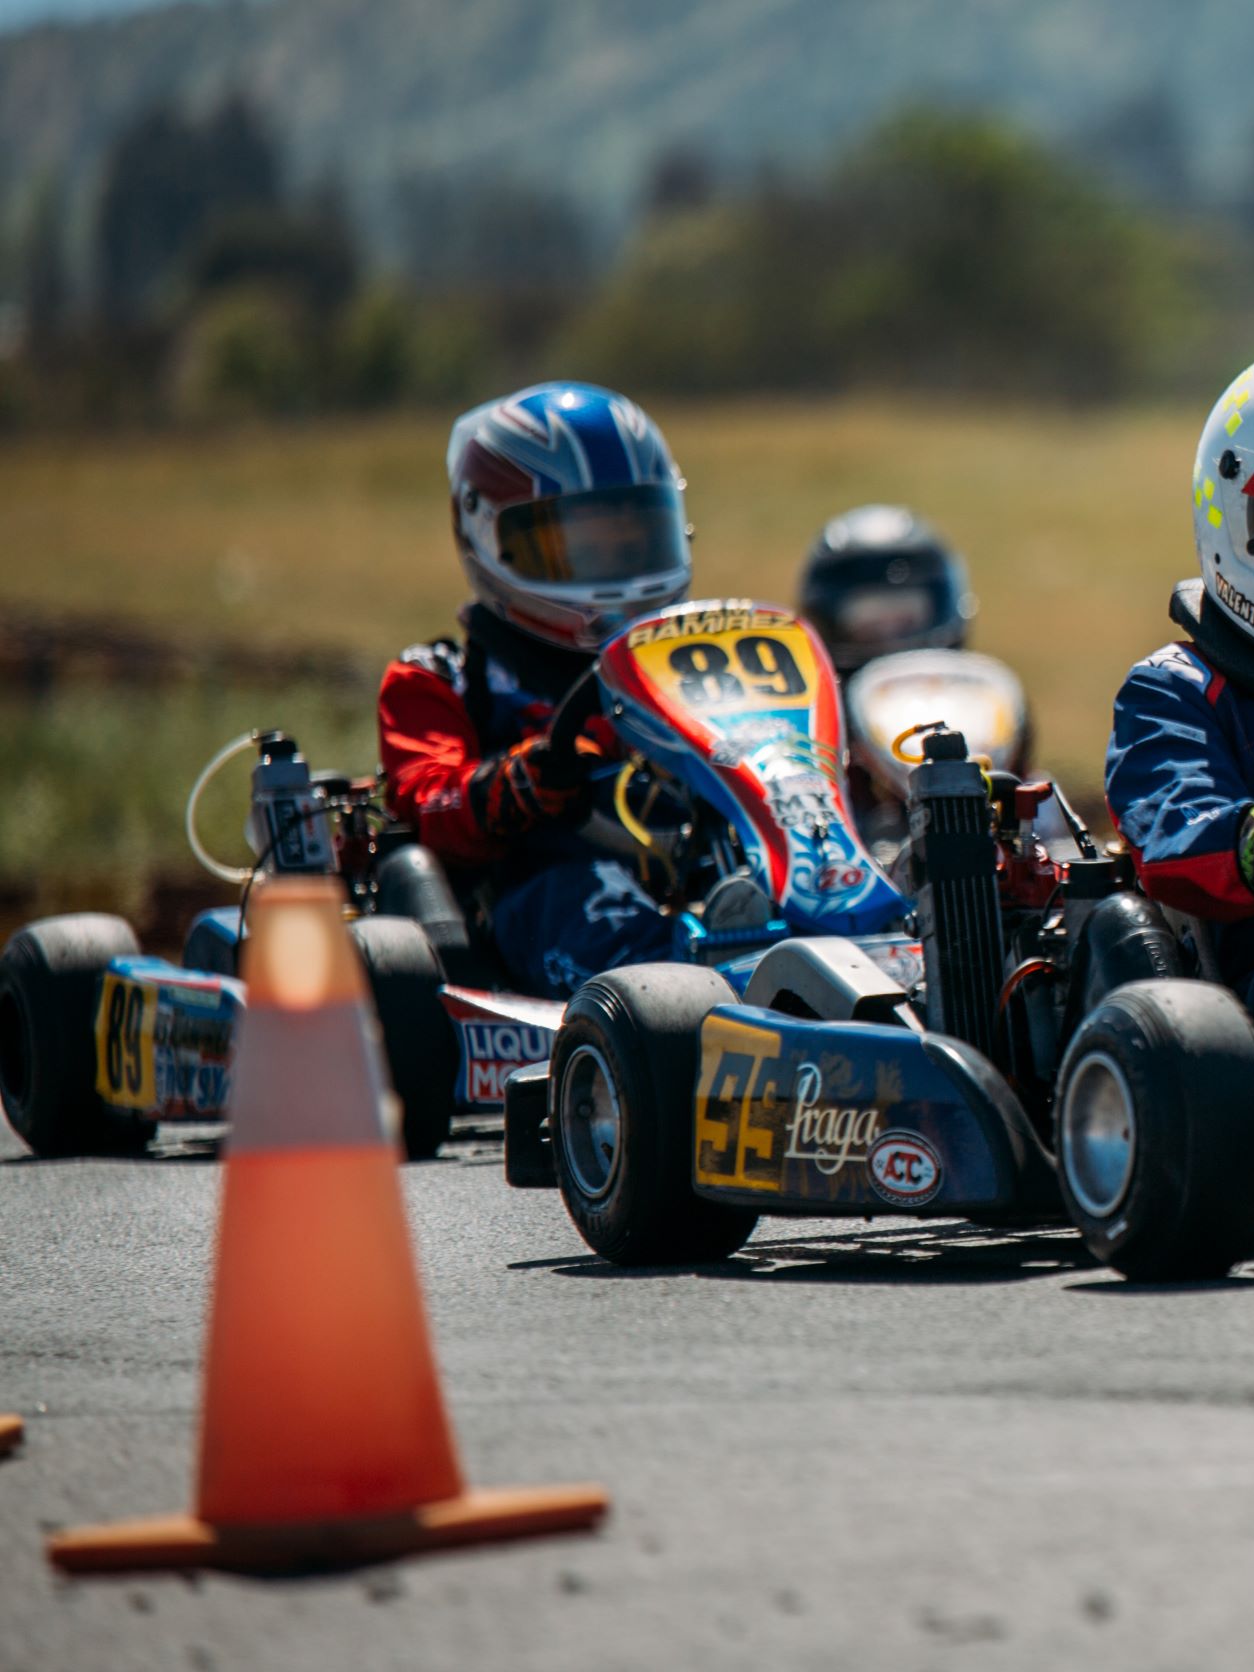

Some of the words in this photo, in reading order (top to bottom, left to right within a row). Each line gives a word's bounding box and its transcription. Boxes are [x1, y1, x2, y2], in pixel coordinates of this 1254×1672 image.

[627, 611, 796, 649] RAMIREZ
[668, 636, 807, 706] 89
[107, 982, 145, 1097] 89
[784, 1061, 882, 1175] Praga
